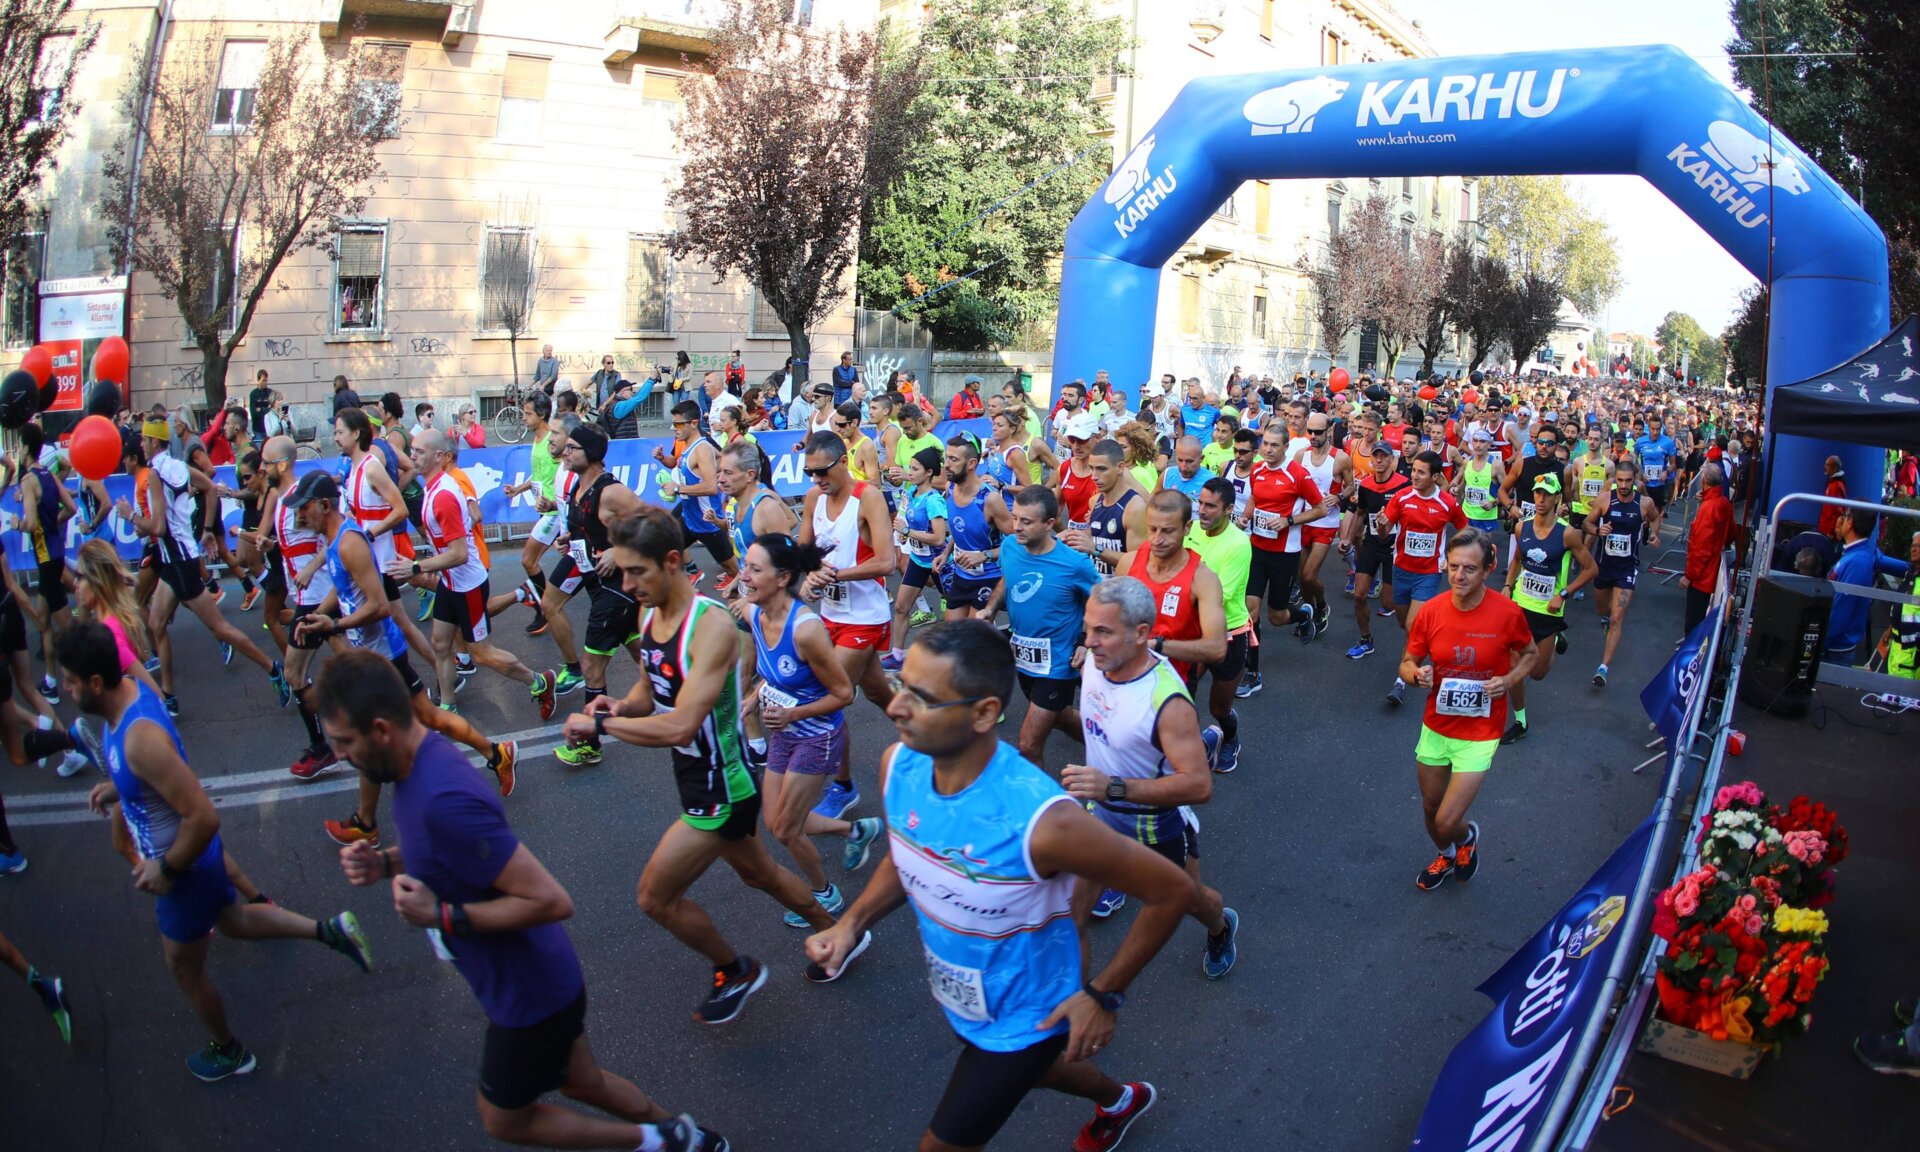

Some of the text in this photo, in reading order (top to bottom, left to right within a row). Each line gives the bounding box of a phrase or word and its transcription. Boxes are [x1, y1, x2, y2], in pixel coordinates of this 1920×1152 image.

[1356, 69, 1567, 127] KARHU
[1356, 130, 1457, 147] www.karhu.com
[1666, 142, 1768, 229] KARHU
[1113, 167, 1177, 239] KARHU
[87, 302, 111, 312] Sistema
[90, 313, 114, 322] Allarme
[1409, 538, 1431, 550] 1262
[1611, 541, 1625, 551] 321
[1526, 580, 1548, 594] 1277
[1020, 639, 1048, 648] KARHU
[1017, 645, 1036, 663] 361
[1459, 683, 1483, 691] KARH
[1451, 692, 1478, 707] 562
